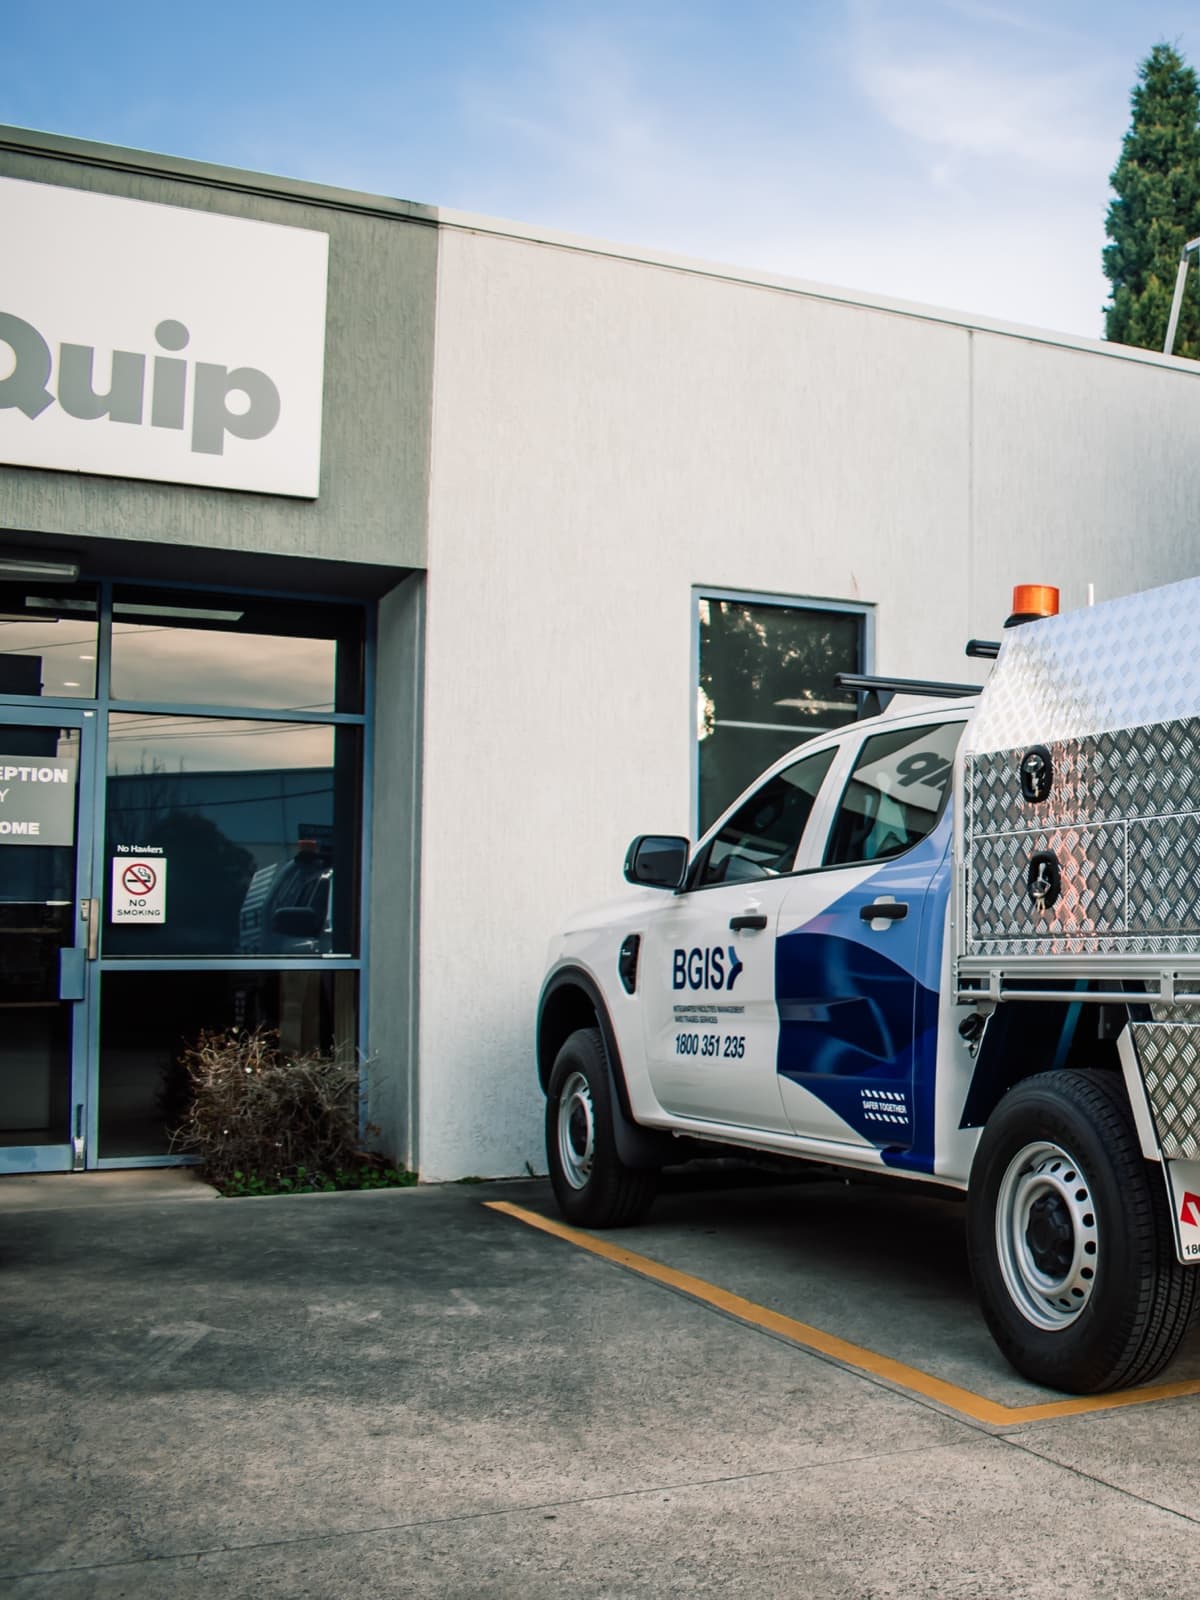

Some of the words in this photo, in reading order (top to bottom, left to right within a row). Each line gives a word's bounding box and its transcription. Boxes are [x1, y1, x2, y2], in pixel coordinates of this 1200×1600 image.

[117, 844, 129, 853] No
[131, 845, 164, 854] Hawkers
[129, 899, 147, 907] NO
[673, 946, 725, 991] BGIS
[676, 1033, 699, 1056] 1800
[701, 1034, 721, 1057] 351
[724, 1035, 746, 1059] 235
